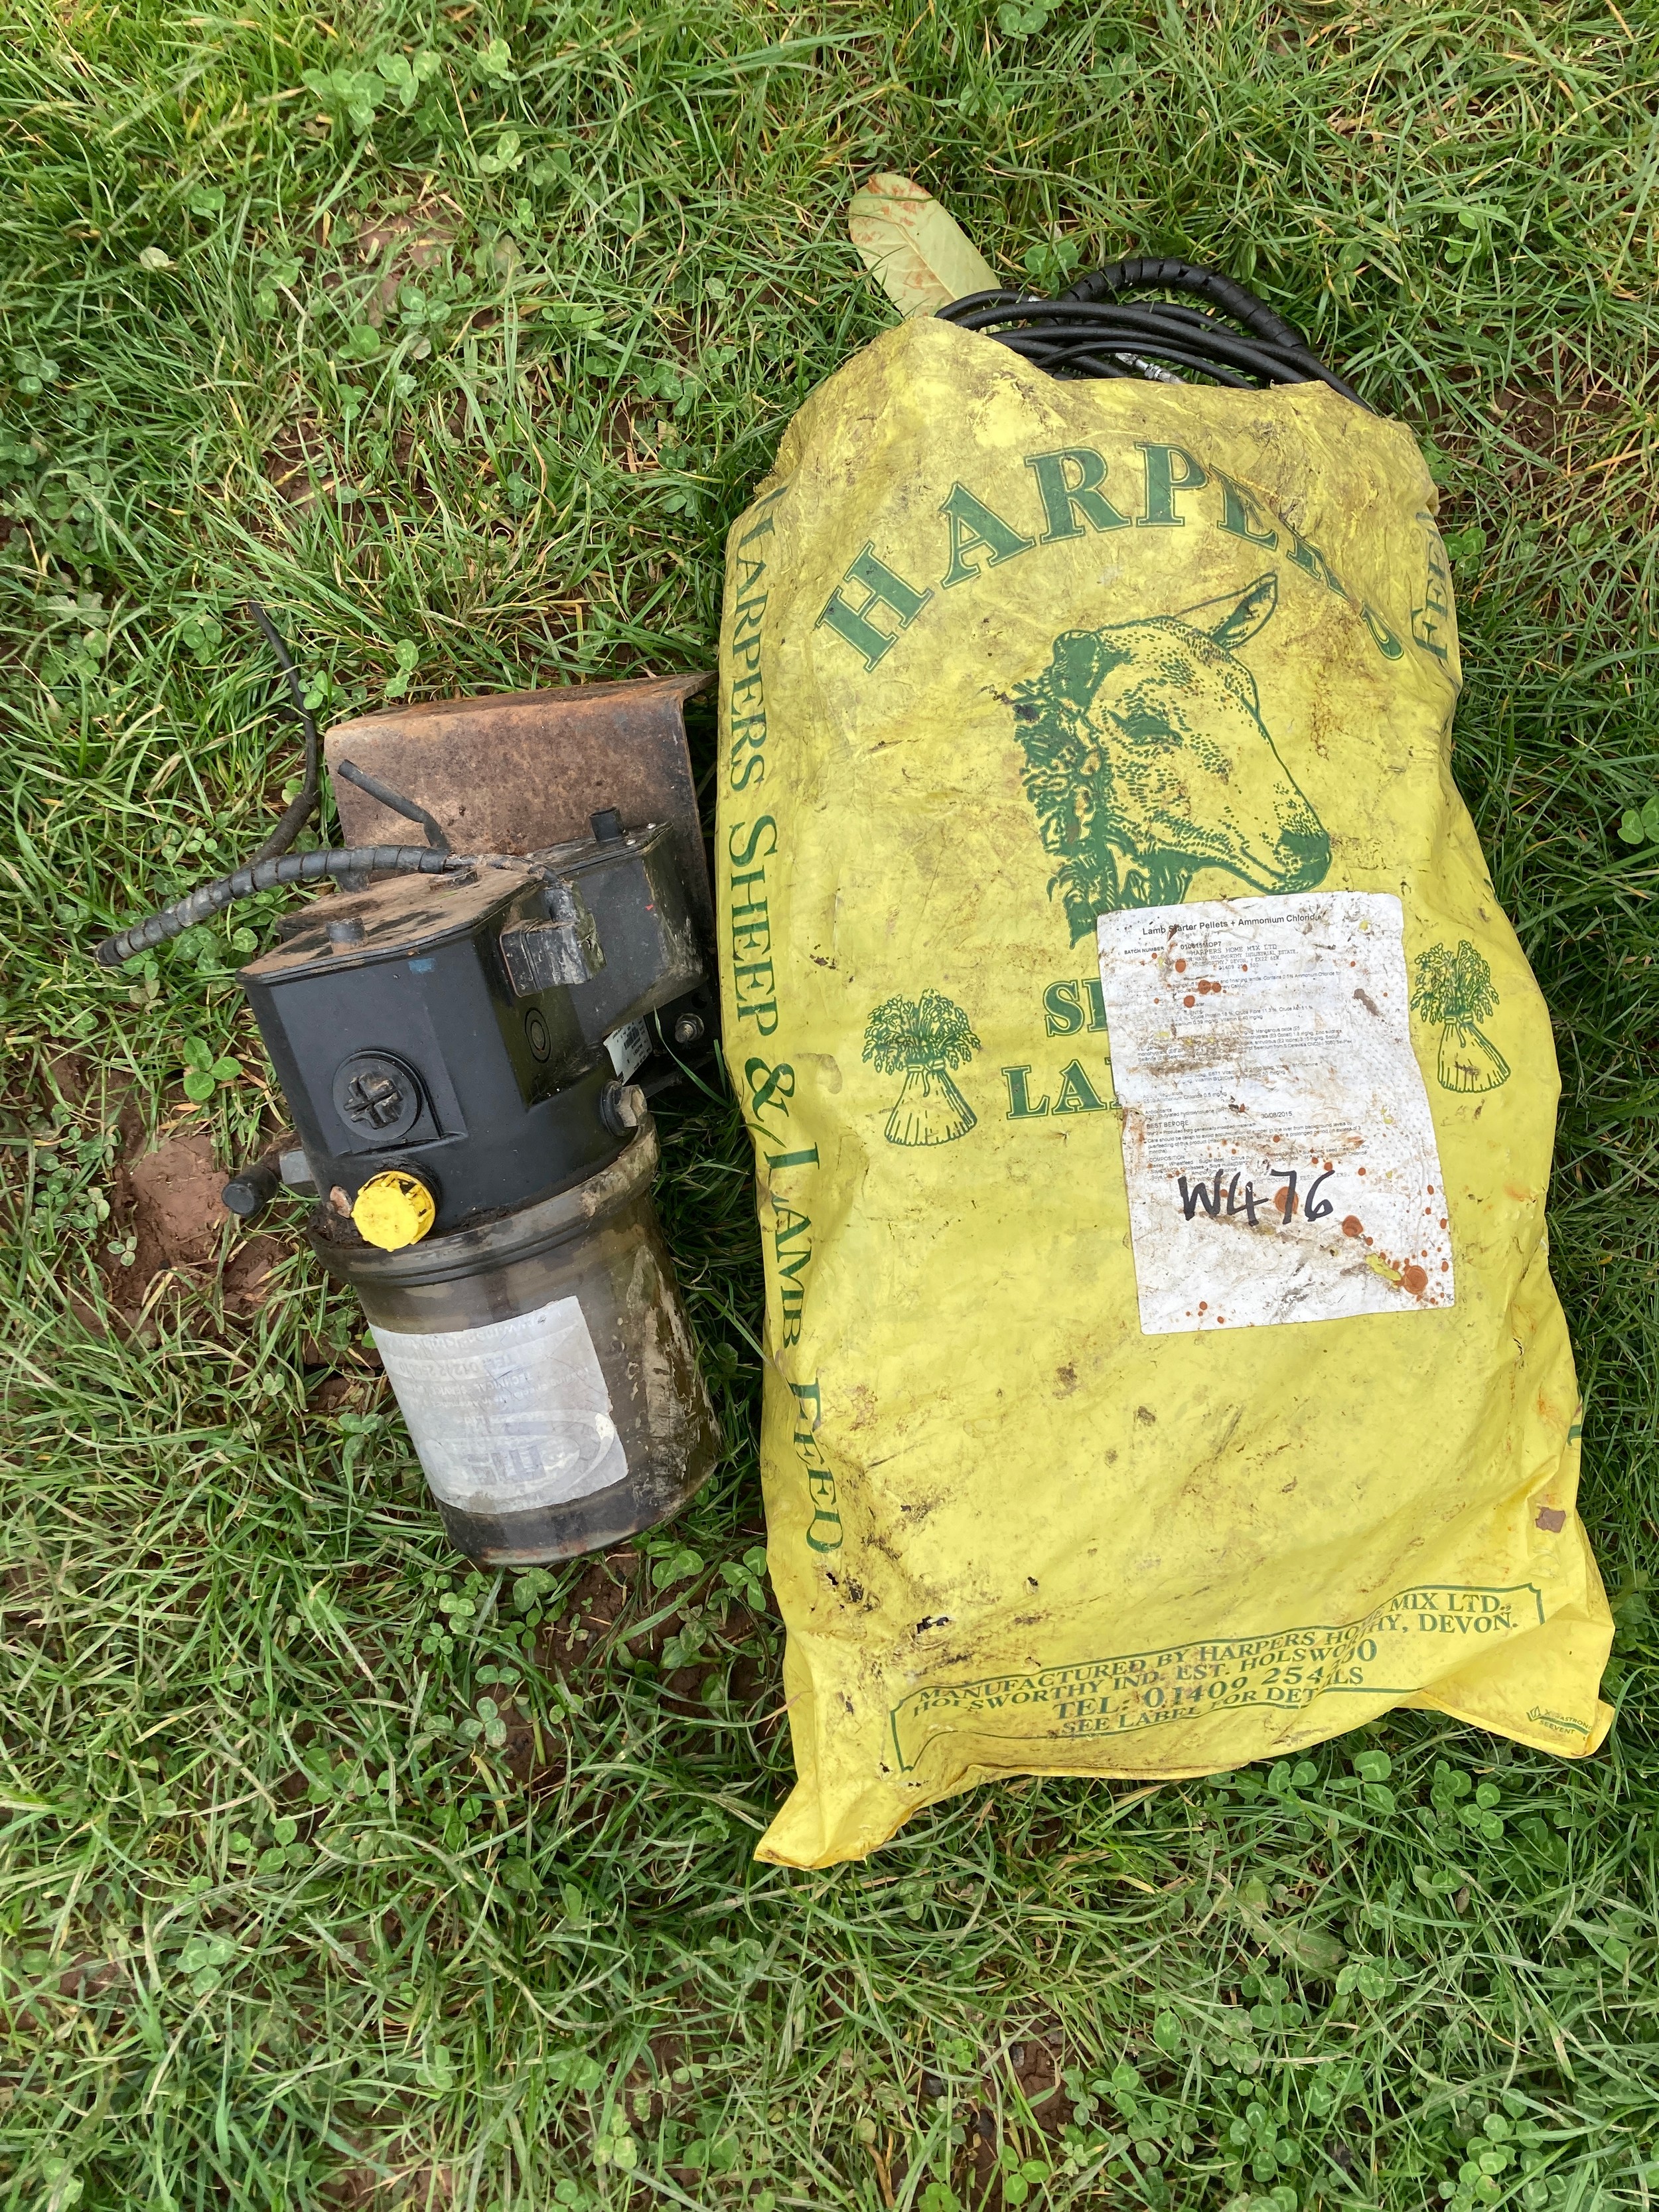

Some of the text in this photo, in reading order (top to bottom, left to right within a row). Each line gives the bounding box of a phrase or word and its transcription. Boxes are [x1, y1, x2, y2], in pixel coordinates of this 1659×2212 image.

[729, 814, 780, 1037] SHEEP
[1142, 926, 1167, 936] Lamb
[1199, 921, 1229, 929] Pellets
[1238, 916, 1285, 926] Ammonium
[1286, 913, 1322, 922] Chloride
[1190, 948, 1222, 956] HARPERS
[745, 1056, 796, 1122] &
[1001, 1058, 1123, 1120] LA
[1260, 1111, 1293, 1120] 30/08/2015
[763, 1142, 820, 1349] LAMB
[786, 1376, 843, 1554] FEED
[912, 1679, 1104, 1718] HOLSWORTHY
[1175, 1663, 1230, 1681] EST.
[1418, 1611, 1518, 1635] DEVON.
[919, 1659, 1146, 1702] MANUFACTURED
[1155, 1649, 1190, 1669] BY
[1199, 1631, 1317, 1662] HARPERS
[1388, 1592, 1439, 1612] MIX
[1051, 1696, 1130, 1720] TEL:
[1143, 1676, 1249, 1709] 01409
[1261, 1666, 1324, 1686] 254
[1060, 1666, 1364, 1735] SEE LABEL FOR DETLS
[1540, 1720, 1576, 1735] SEEVENT
